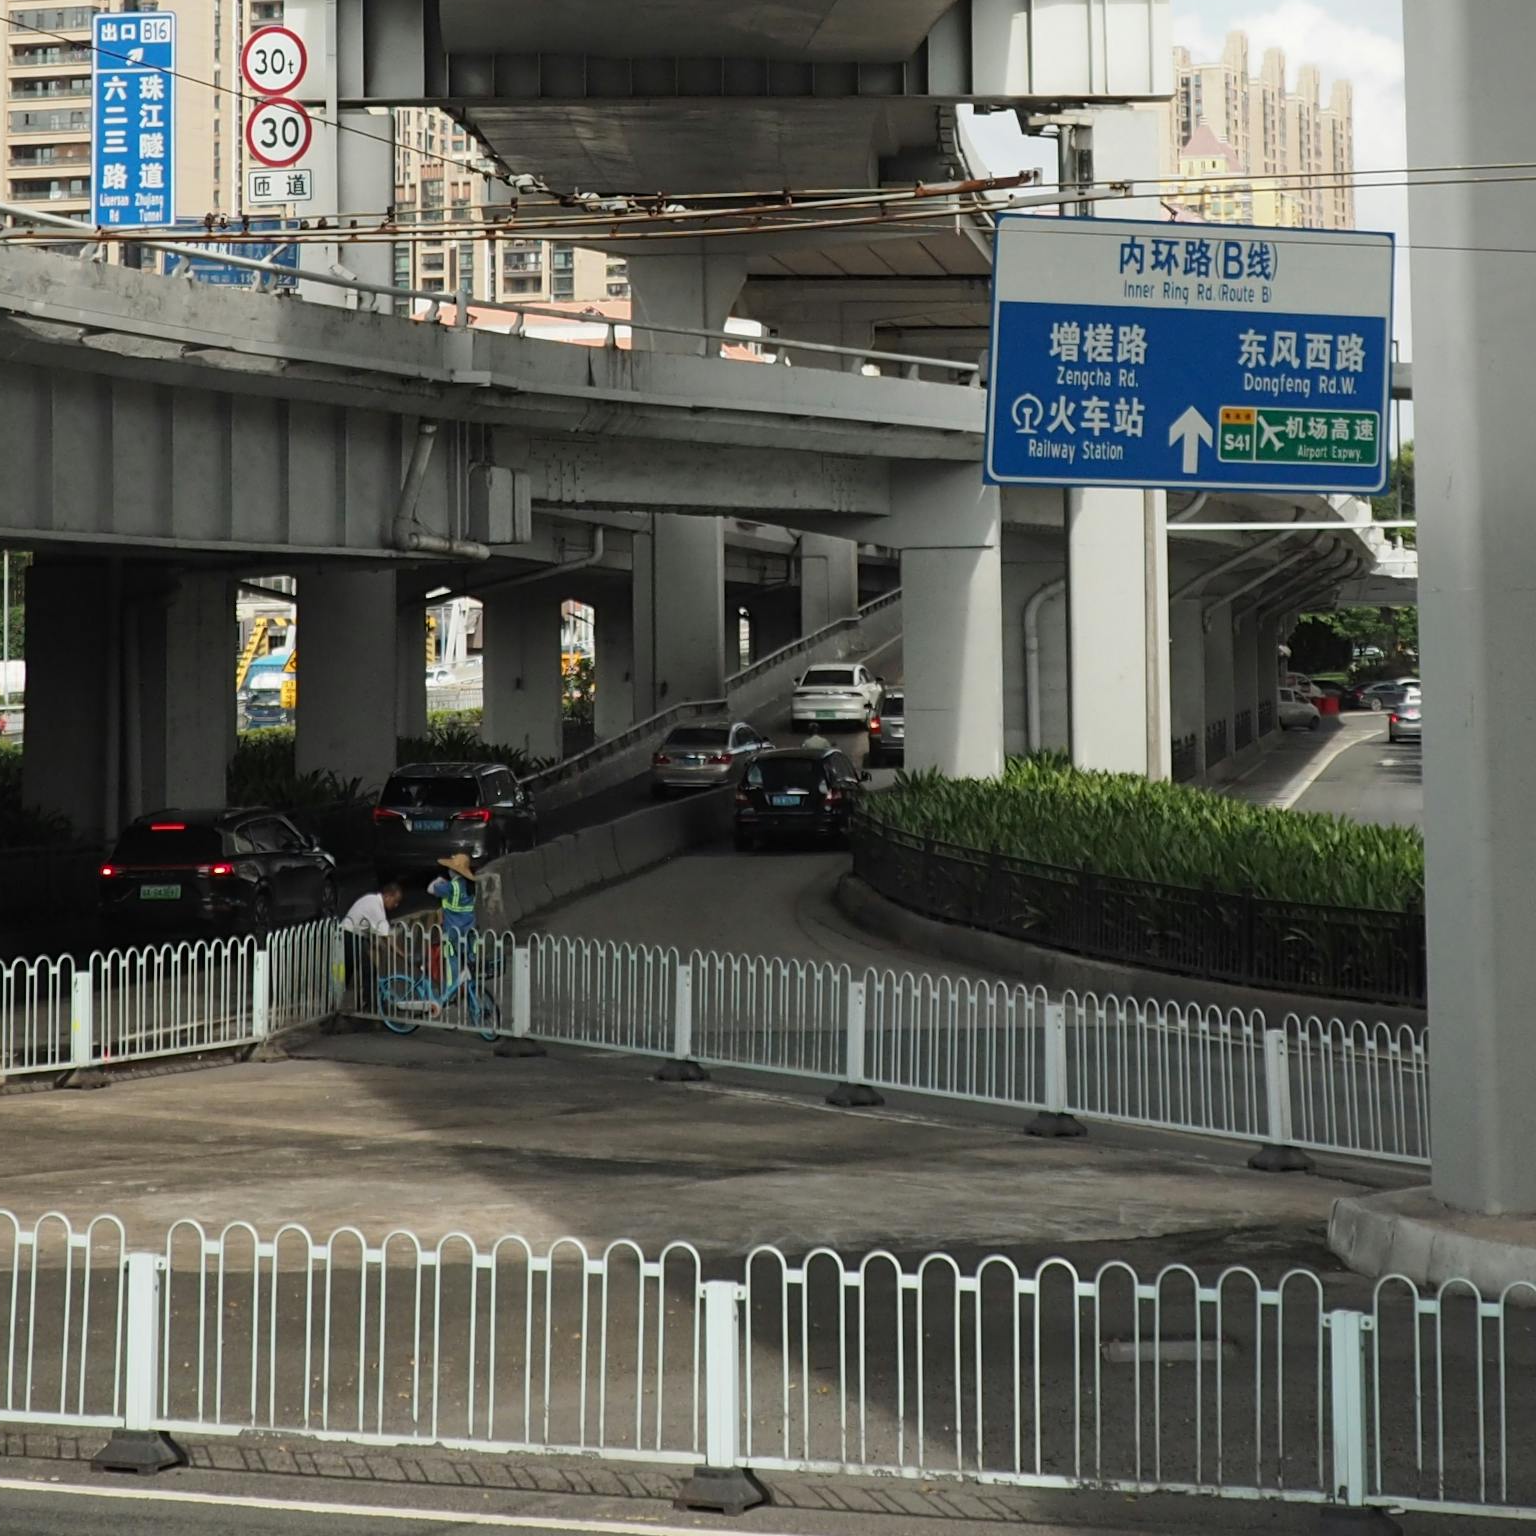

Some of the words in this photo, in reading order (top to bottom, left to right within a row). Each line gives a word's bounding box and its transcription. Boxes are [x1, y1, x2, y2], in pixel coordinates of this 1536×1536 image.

[101, 22, 137, 42] 出口
[143, 21, 169, 42] B16
[102, 75, 128, 190] 六二三路
[138, 74, 165, 190] 珠江隧道
[260, 116, 300, 149] 30
[253, 174, 307, 197] 匝道
[1119, 236, 1279, 282] 内环路(B线)
[1123, 281, 1155, 300] Inner
[1163, 282, 1190, 305] Ring
[1261, 285, 1273, 305] B)
[1048, 322, 1148, 366] 增槎路
[1237, 329, 1366, 374] 东风西路
[1056, 366, 1112, 391] Zengcha
[1118, 367, 1140, 388] Rd.
[1243, 372, 1311, 398] Dongfeng
[1046, 395, 1146, 439] 火车站
[1285, 415, 1376, 443] 机场高速
[1028, 438, 1076, 464] Railway
[1082, 442, 1124, 461] Station
[1224, 433, 1251, 452] S41
[1297, 445, 1329, 462] Airport
[1331, 447, 1363, 464] Expwy.
